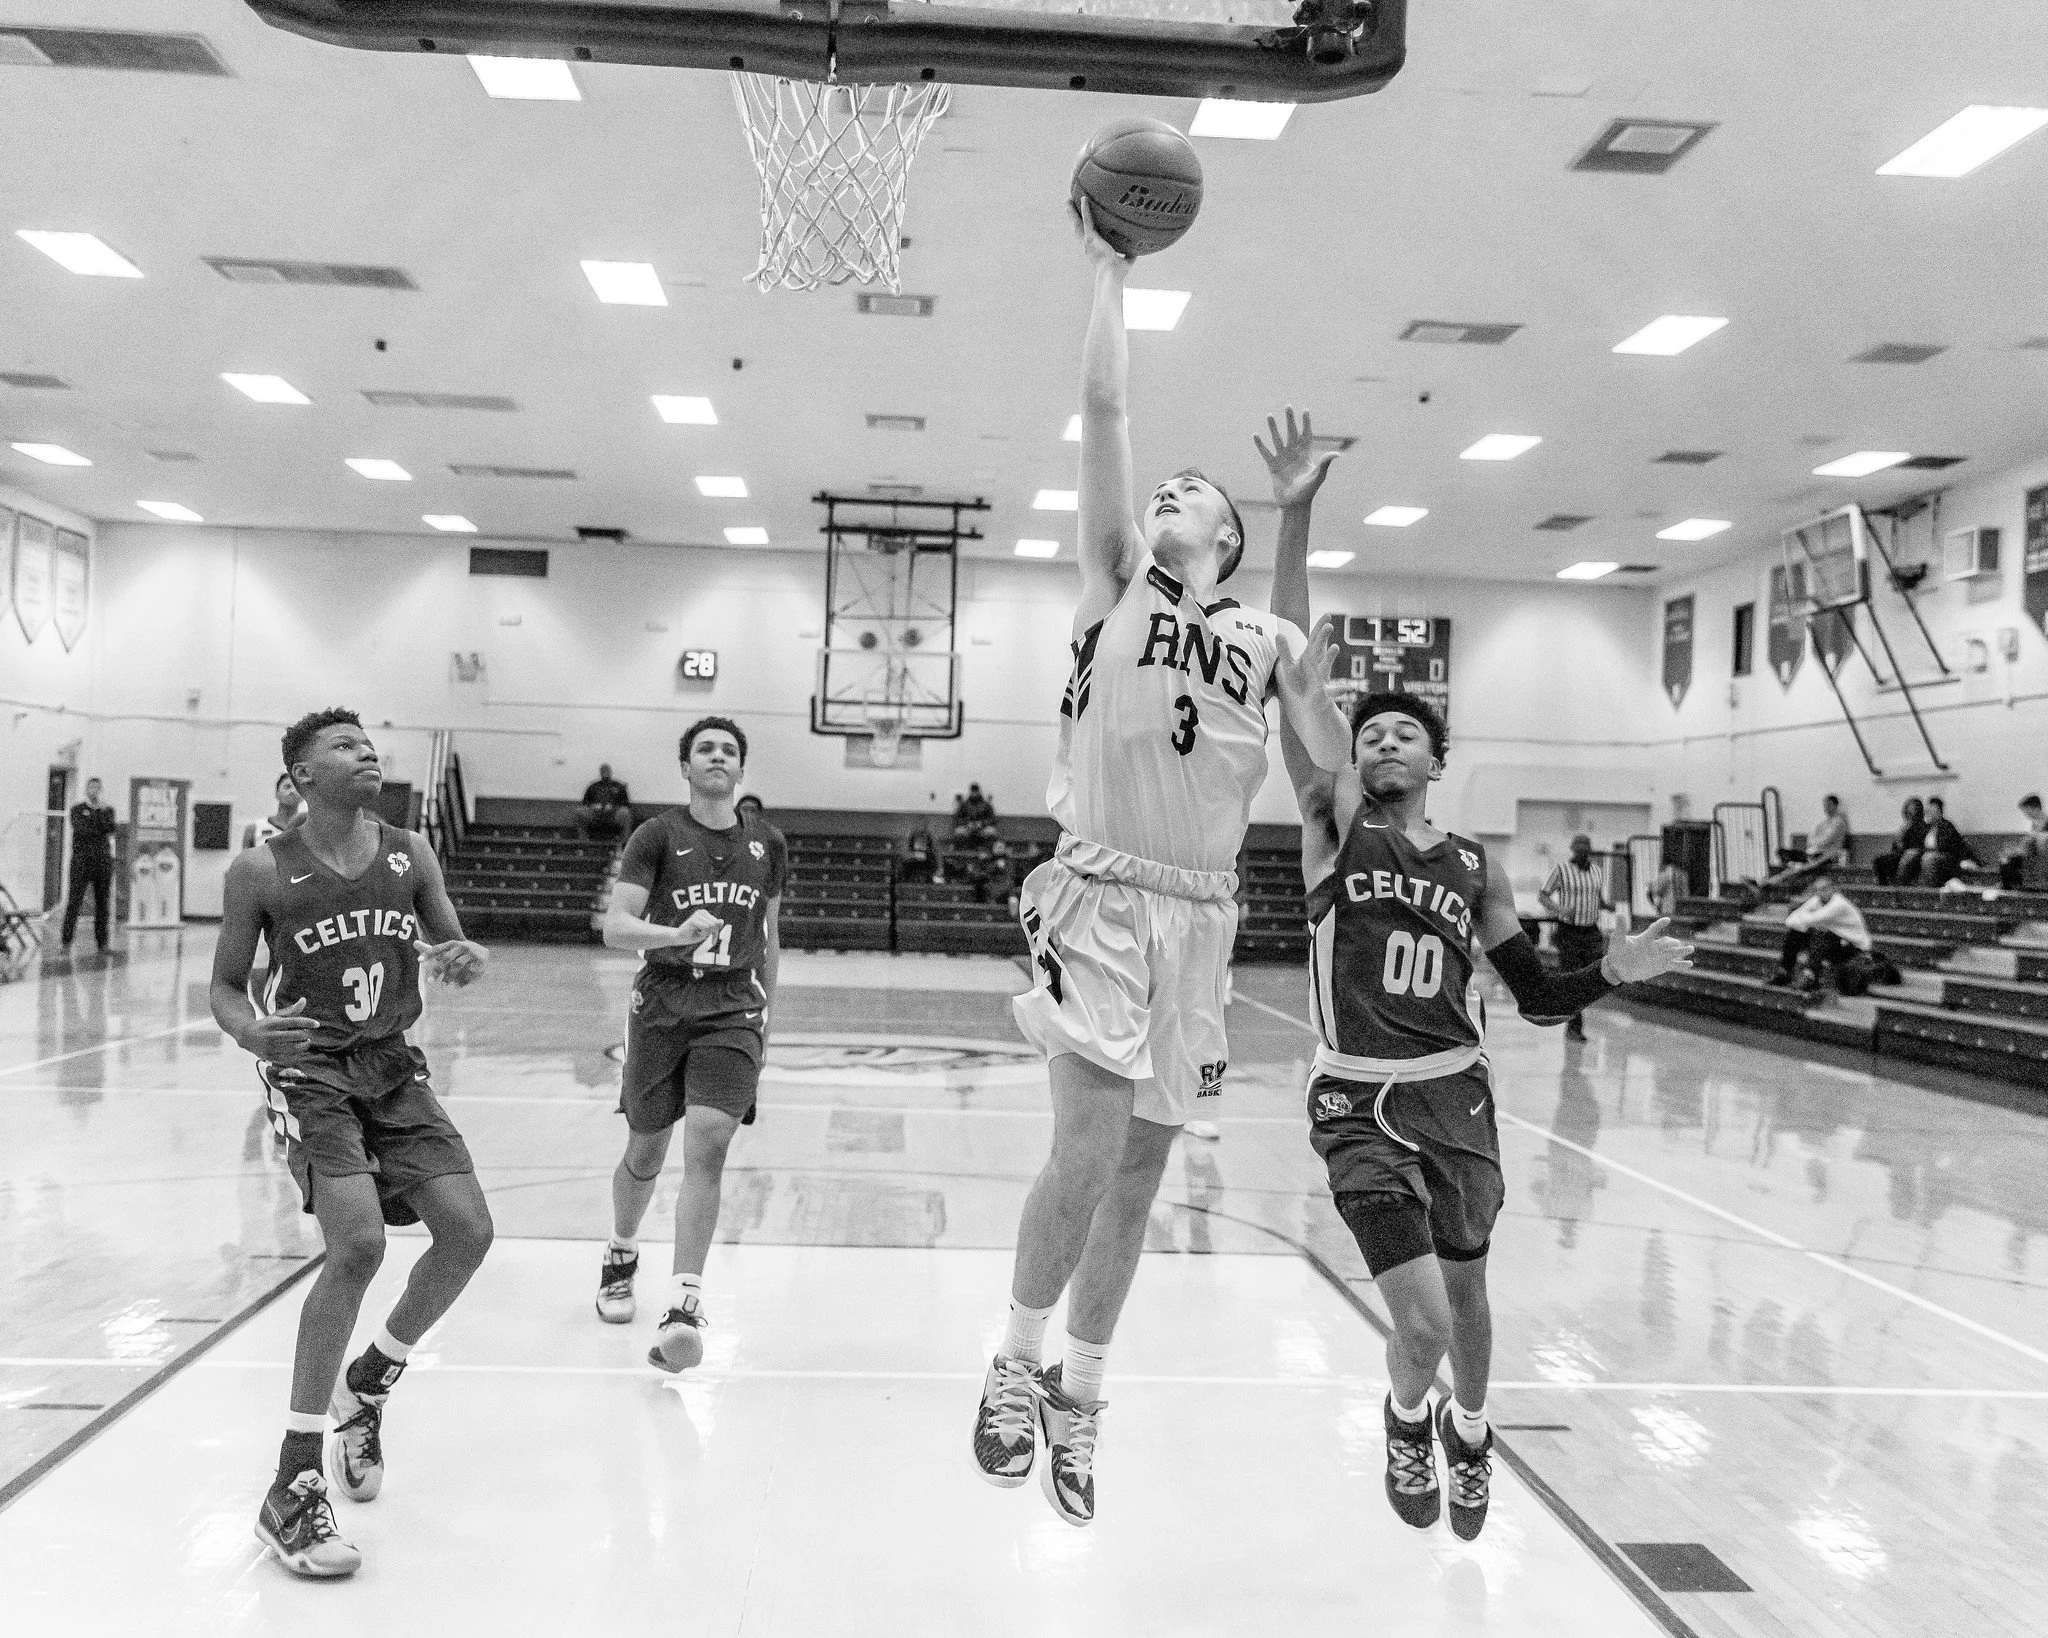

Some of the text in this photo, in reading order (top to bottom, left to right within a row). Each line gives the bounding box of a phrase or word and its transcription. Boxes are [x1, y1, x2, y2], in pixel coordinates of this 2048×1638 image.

[684, 651, 714, 676] 28
[1171, 694, 1200, 756] 3
[672, 881, 760, 910] CELTICS
[1345, 870, 1471, 938] CELTICS
[294, 909, 415, 954] CELTICS
[342, 962, 384, 1022] 30
[1382, 930, 1444, 998] 00
